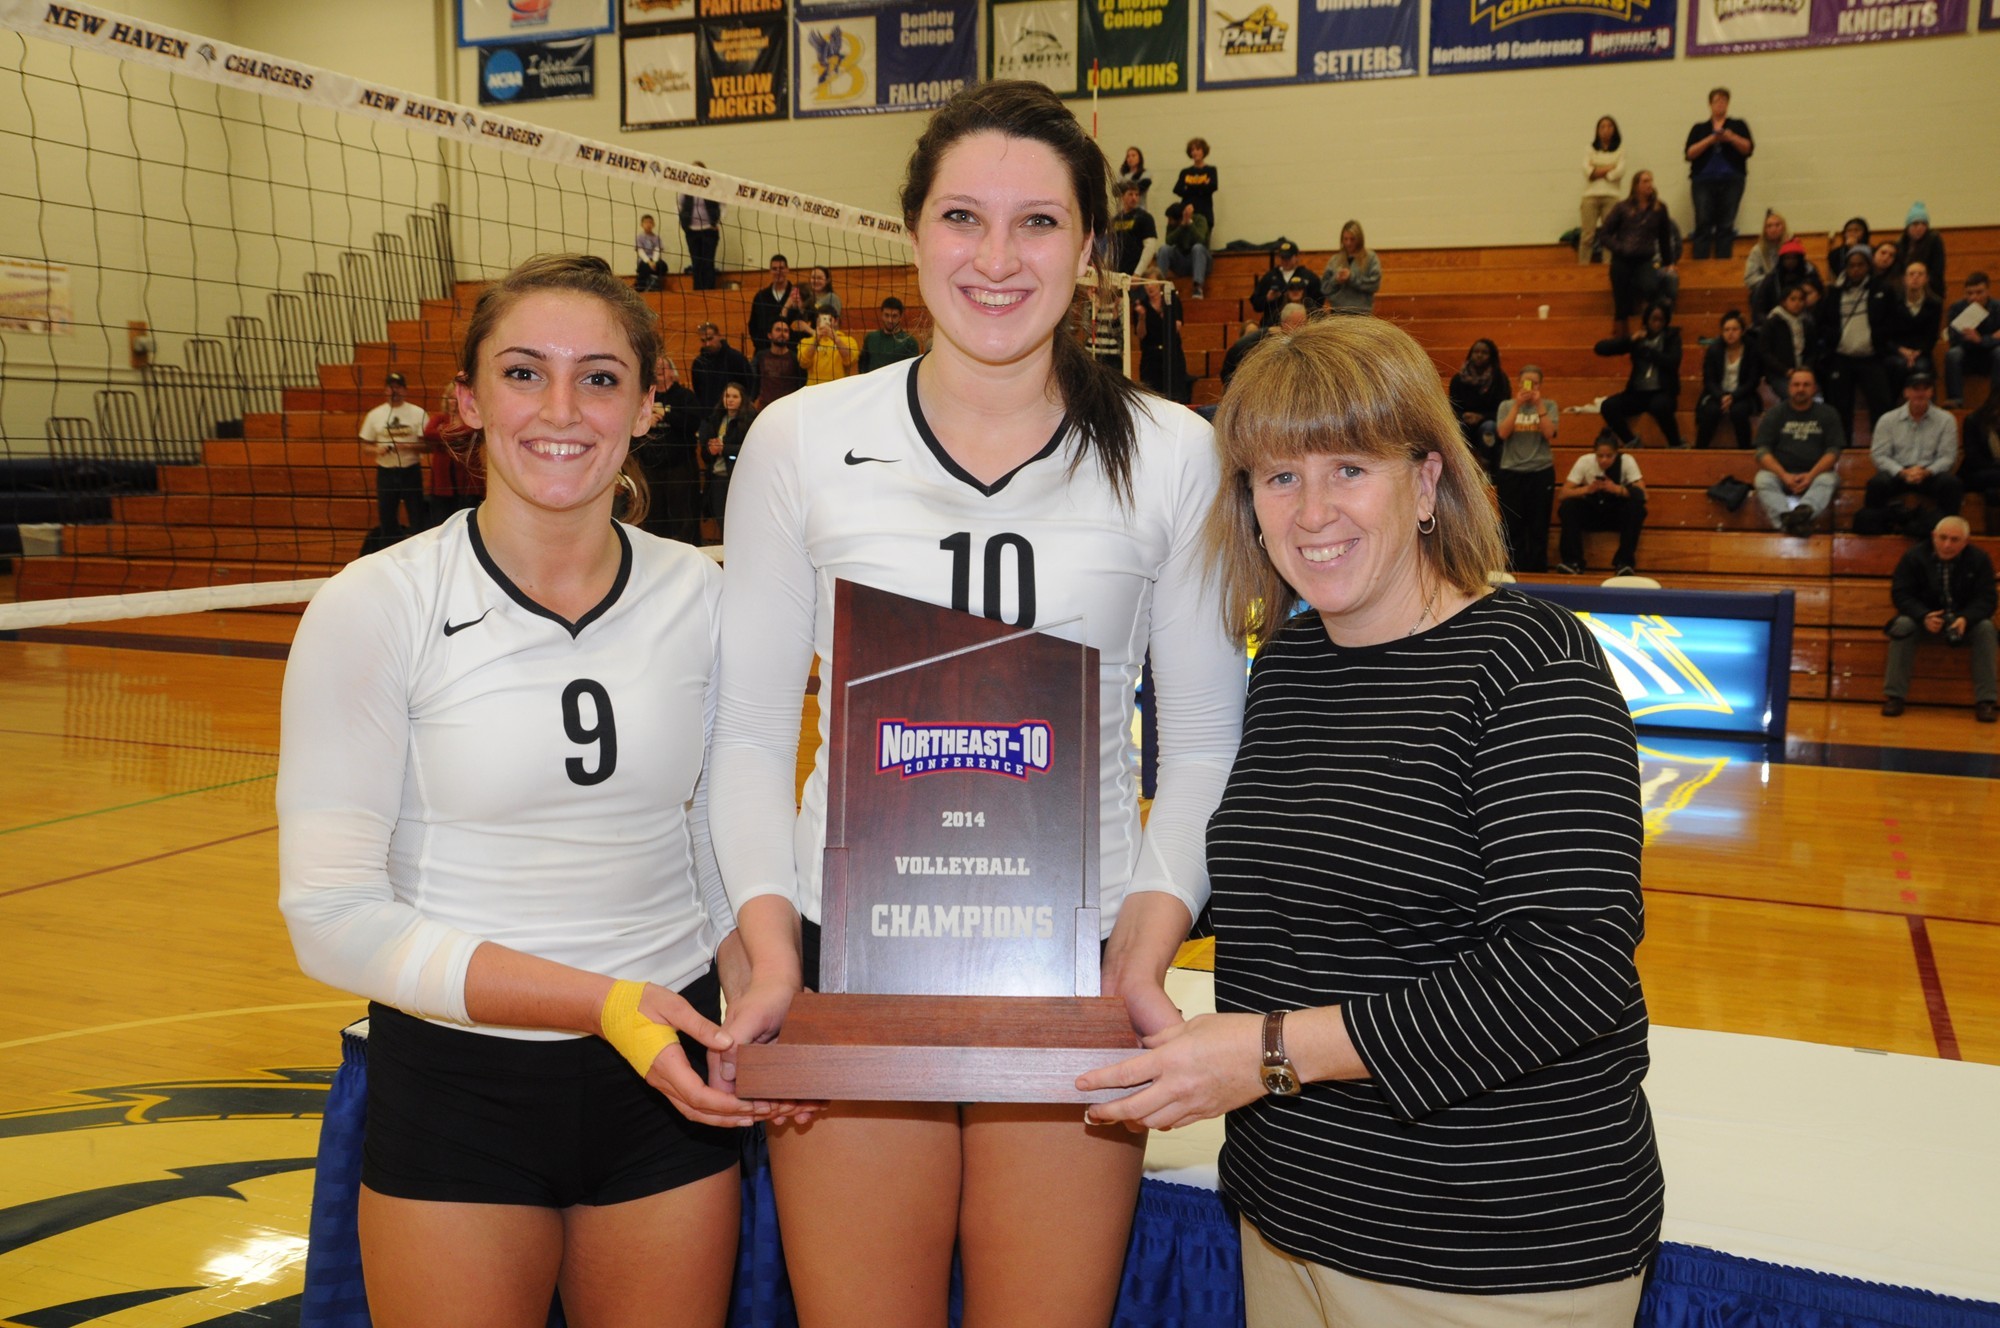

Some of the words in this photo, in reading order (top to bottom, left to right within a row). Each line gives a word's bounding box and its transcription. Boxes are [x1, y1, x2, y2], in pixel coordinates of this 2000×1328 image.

[900, 10, 954, 30] Bentley
[1103, 9, 1163, 30] College
[1838, 1, 1938, 35] KNIGHTS
[44, 3, 107, 36] NEW
[109, 20, 189, 59] HAVEN
[224, 53, 314, 91] CHARGERS
[900, 27, 954, 47] College
[1220, 26, 1286, 47] PACE
[1314, 45, 1402, 76] SETTERS
[1432, 41, 1509, 65] Northeast-10
[1511, 38, 1585, 60] Conference
[711, 73, 772, 97] YELLOW
[1087, 62, 1179, 91] DOLPHINS
[889, 79, 965, 105] FALCONS
[359, 89, 399, 112] NEW
[404, 100, 458, 128] HAVEN
[481, 119, 544, 148] CHARGERS
[709, 93, 776, 119] JACKETS
[576, 144, 604, 162] NEW
[606, 151, 648, 173] HAVEN
[663, 166, 712, 188] CHARGERS
[736, 184, 758, 199] NEW
[759, 190, 791, 207] HAVEN
[802, 200, 841, 219] CHARGERS
[857, 214, 876, 228] NEW
[939, 532, 1037, 630] 10
[561, 678, 617, 786] 9
[881, 724, 1049, 769] NORTHEAST-10
[904, 756, 1025, 776] CONFERENCE
[942, 811, 986, 827] 2014
[895, 856, 1030, 876] VOLLEYBALL
[871, 904, 1053, 938] CHAMPIONS
